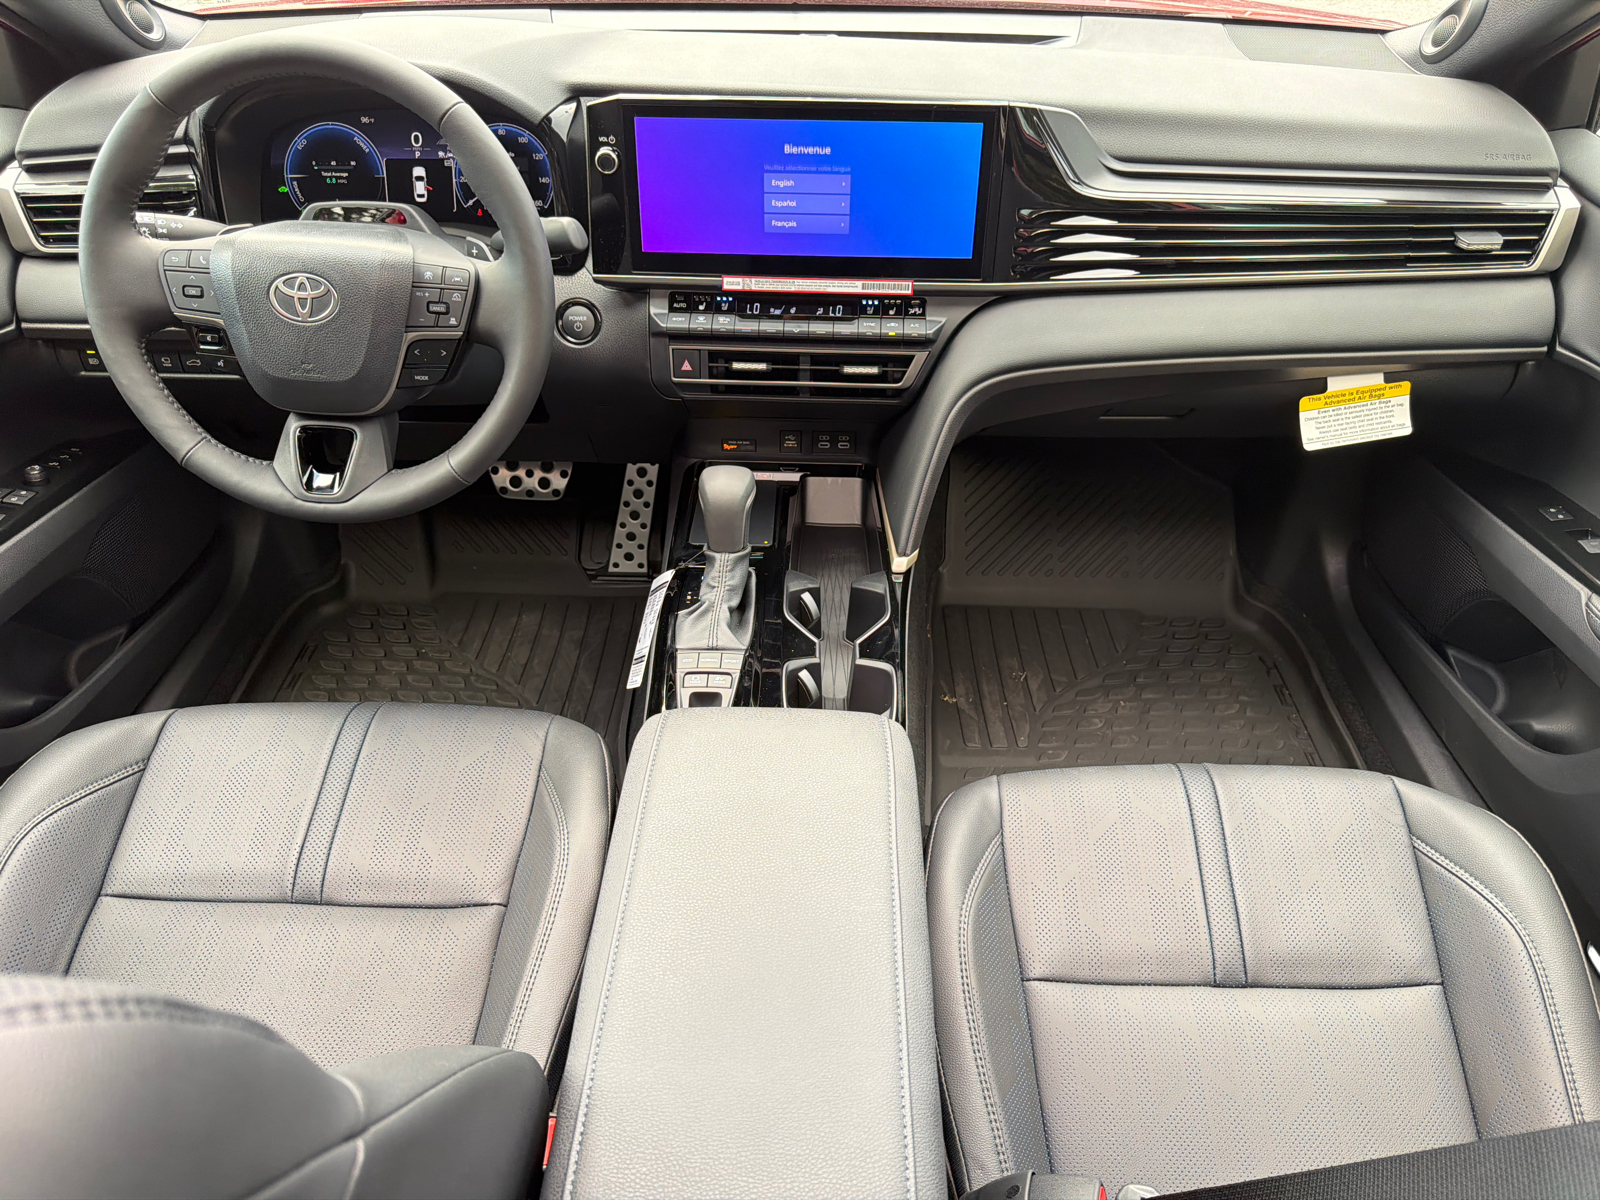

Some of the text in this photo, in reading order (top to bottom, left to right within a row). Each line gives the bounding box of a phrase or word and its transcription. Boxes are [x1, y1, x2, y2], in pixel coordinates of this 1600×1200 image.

[297, 138, 307, 150] ECO
[353, 136, 370, 154] POWER
[411, 132, 422, 147] 0
[784, 143, 831, 155] Bienvenue
[772, 179, 794, 188] English
[772, 200, 796, 208] Español
[772, 220, 797, 228] Français
[747, 303, 760, 314] LO
[829, 305, 843, 316] LO
[1356, 386, 1386, 395] Equipped
[1324, 397, 1356, 406] Advanced
